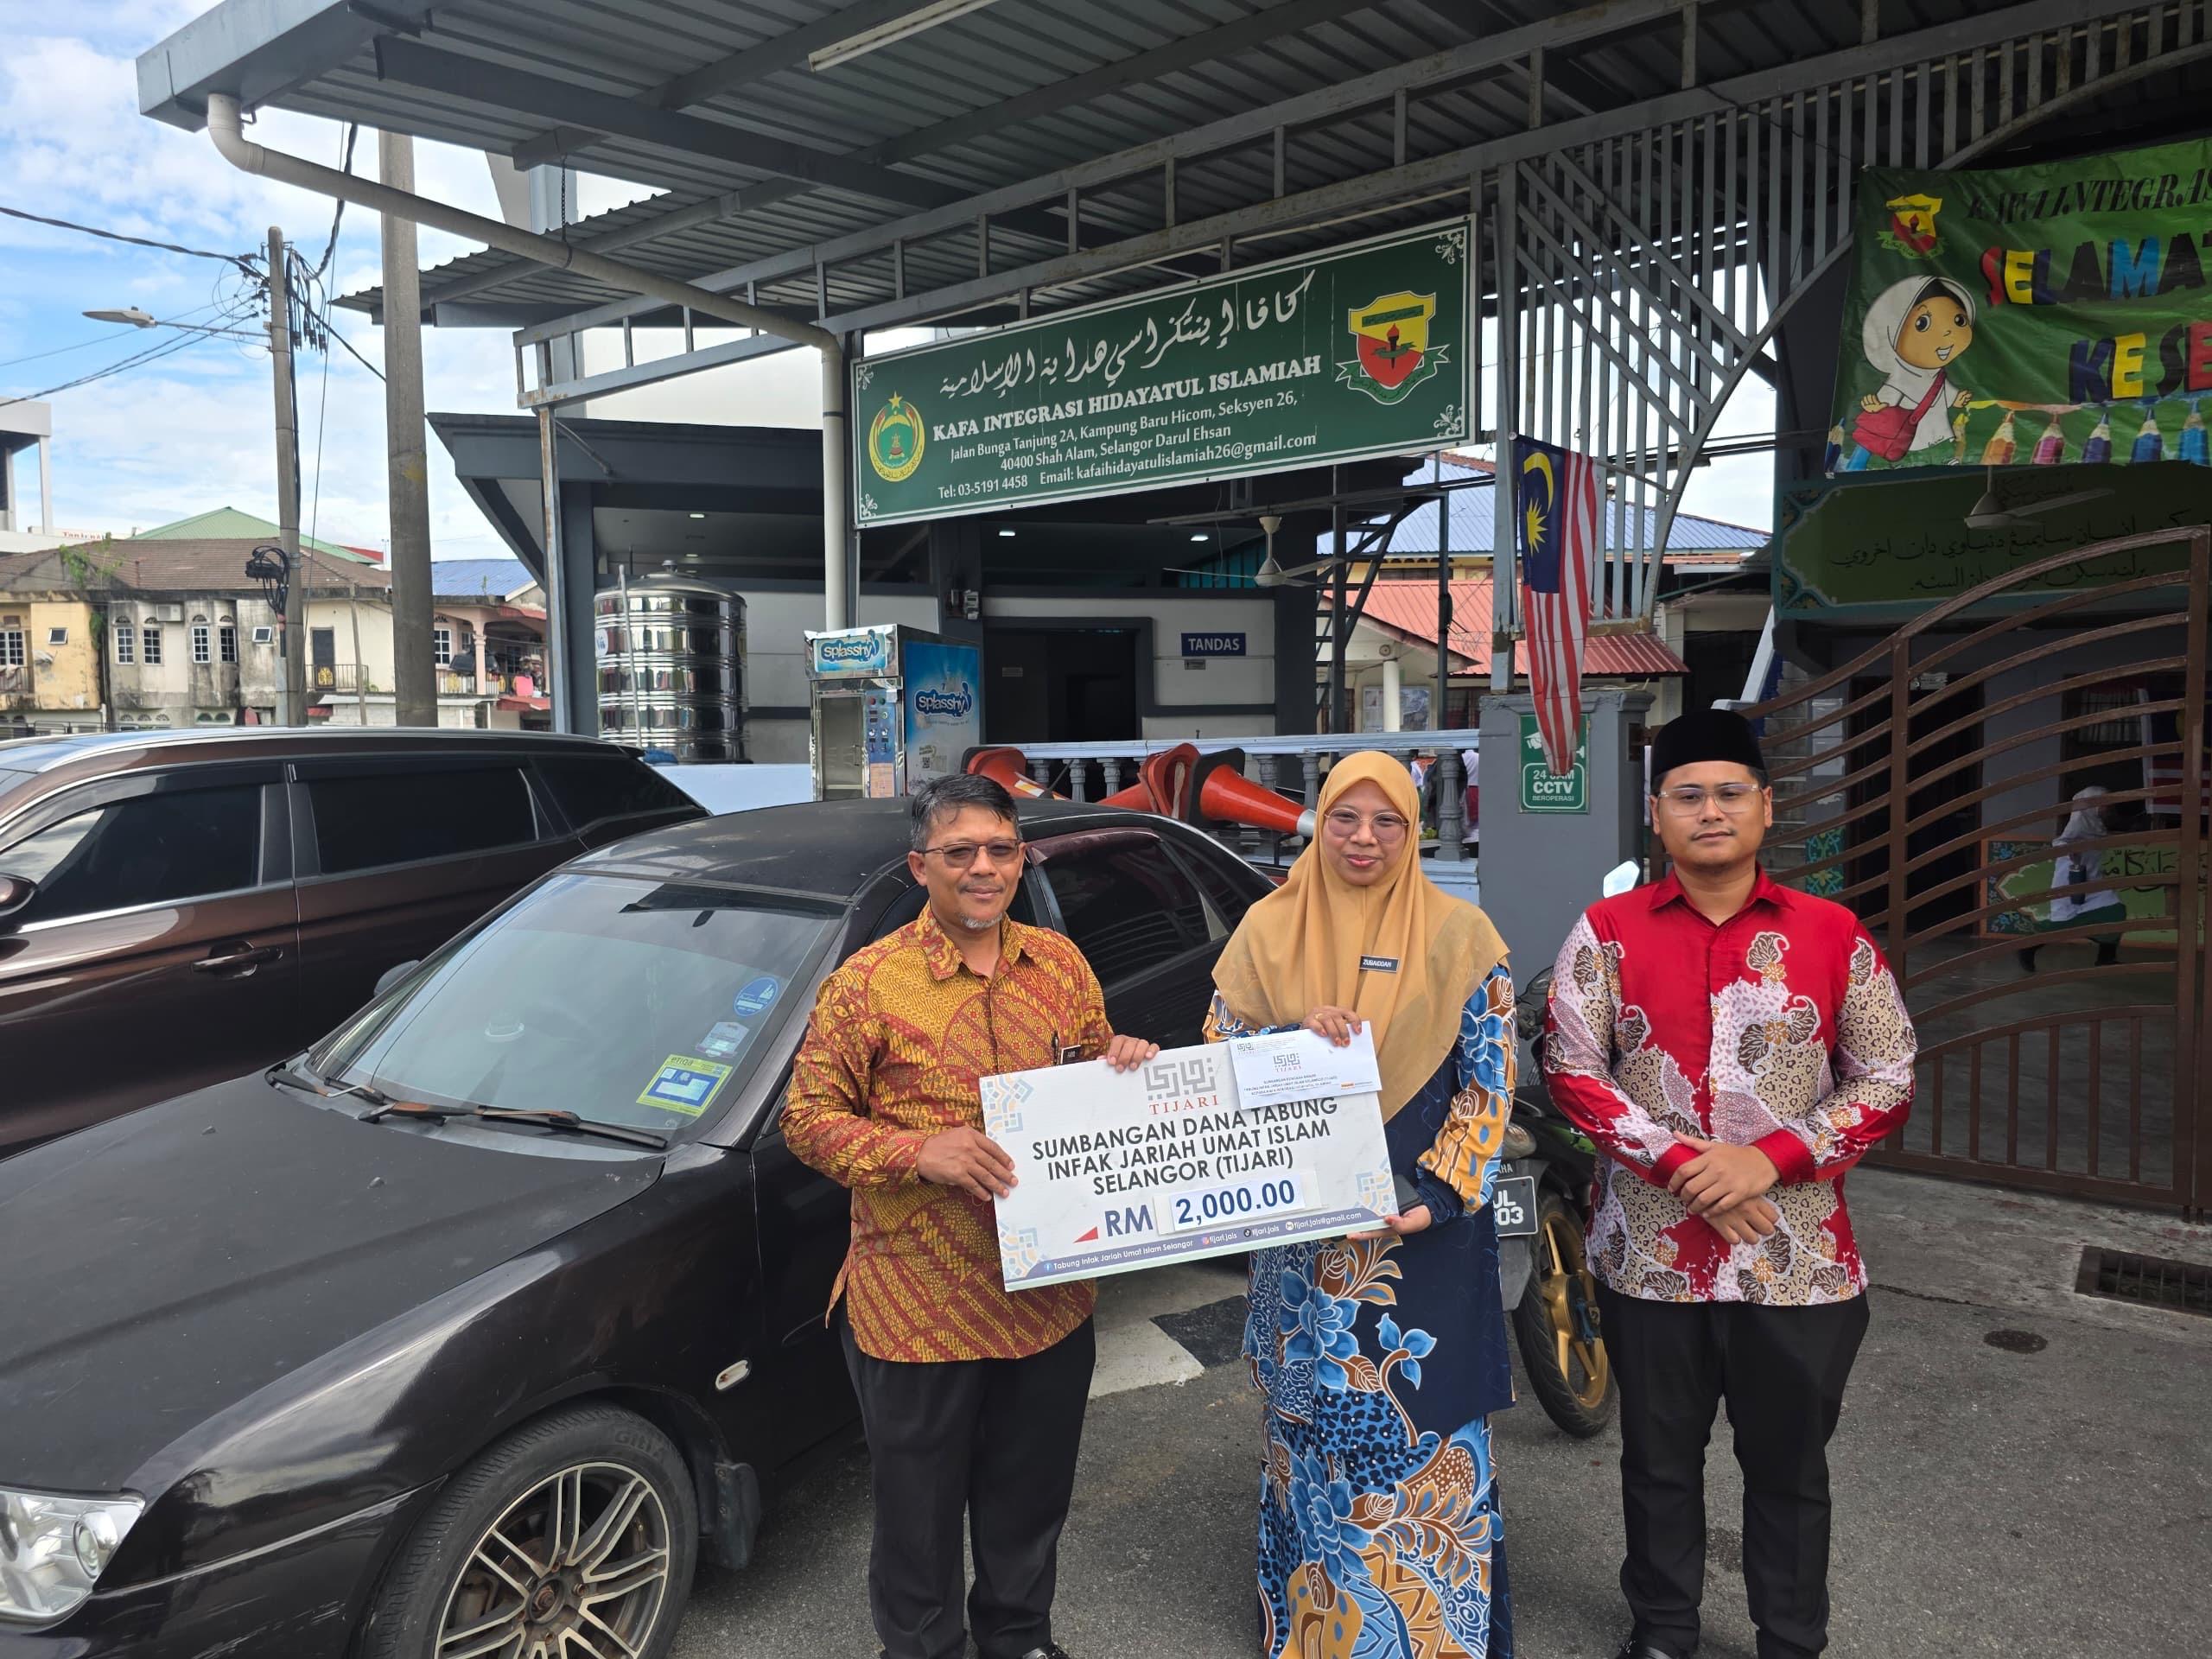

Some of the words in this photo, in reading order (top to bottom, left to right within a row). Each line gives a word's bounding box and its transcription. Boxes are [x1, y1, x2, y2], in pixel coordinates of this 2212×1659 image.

[932, 419, 980, 442] KAFA
[983, 399, 1084, 433] INTEGRASI
[1088, 378, 1205, 415] HIDAYATUL
[1209, 355, 1322, 393] ISLAMIAH
[950, 445, 976, 463] Jalan
[977, 442, 1011, 457] Bunga
[1013, 434, 1058, 451] Tanjung
[1059, 429, 1079, 443] 2A,
[1080, 421, 1138, 440] Kampung
[1140, 416, 1168, 429] Baru
[1171, 407, 1216, 424] Hicom,
[1218, 397, 1274, 416] Seksyen
[1276, 391, 1298, 408] 26,
[1001, 455, 1033, 471] 40400
[1036, 451, 1063, 466] Shah
[1065, 446, 1098, 462] Alam,
[1100, 436, 1154, 456] Selangor
[1156, 428, 1191, 448] Darul
[1193, 426, 1231, 442] Ehsan
[938, 484, 957, 499] Tel:
[957, 480, 1000, 497] 03-5191
[1001, 475, 1028, 490] 4458
[1039, 467, 1074, 485] Email:
[1077, 434, 1317, 476] kafaihidayatulislamiah26@gmail.com
[1188, 639, 1240, 651] TANDAS
[1533, 769, 1548, 780] 24
[1533, 781, 1574, 794] CCTV
[1033, 1121, 1176, 1160] SUMBANGAN
[1183, 1110, 1247, 1136] DANA
[1251, 1096, 1338, 1125] TABUNG
[1149, 1095, 1219, 1115] TIJARI
[1048, 1153, 1114, 1180] INFAK
[1120, 1140, 1196, 1169] JARIAH
[1203, 1129, 1261, 1155] UMAT
[1268, 1119, 1331, 1145] ISLAM
[1093, 1160, 1210, 1195] SELANGOR
[1216, 1146, 1294, 1179] (TIJARI)
[1104, 1204, 1154, 1236] RM
[1175, 1179, 1294, 1225] 2,000.00
[1494, 1206, 1524, 1226] 03
[1053, 1258, 1080, 1270] Tabung
[1081, 1255, 1100, 1266] Infak
[1101, 1252, 1122, 1262] Jariah
[1123, 1249, 1142, 1258] Umat
[1143, 1245, 1162, 1255] Islam
[1162, 1239, 1193, 1252] Selangor
